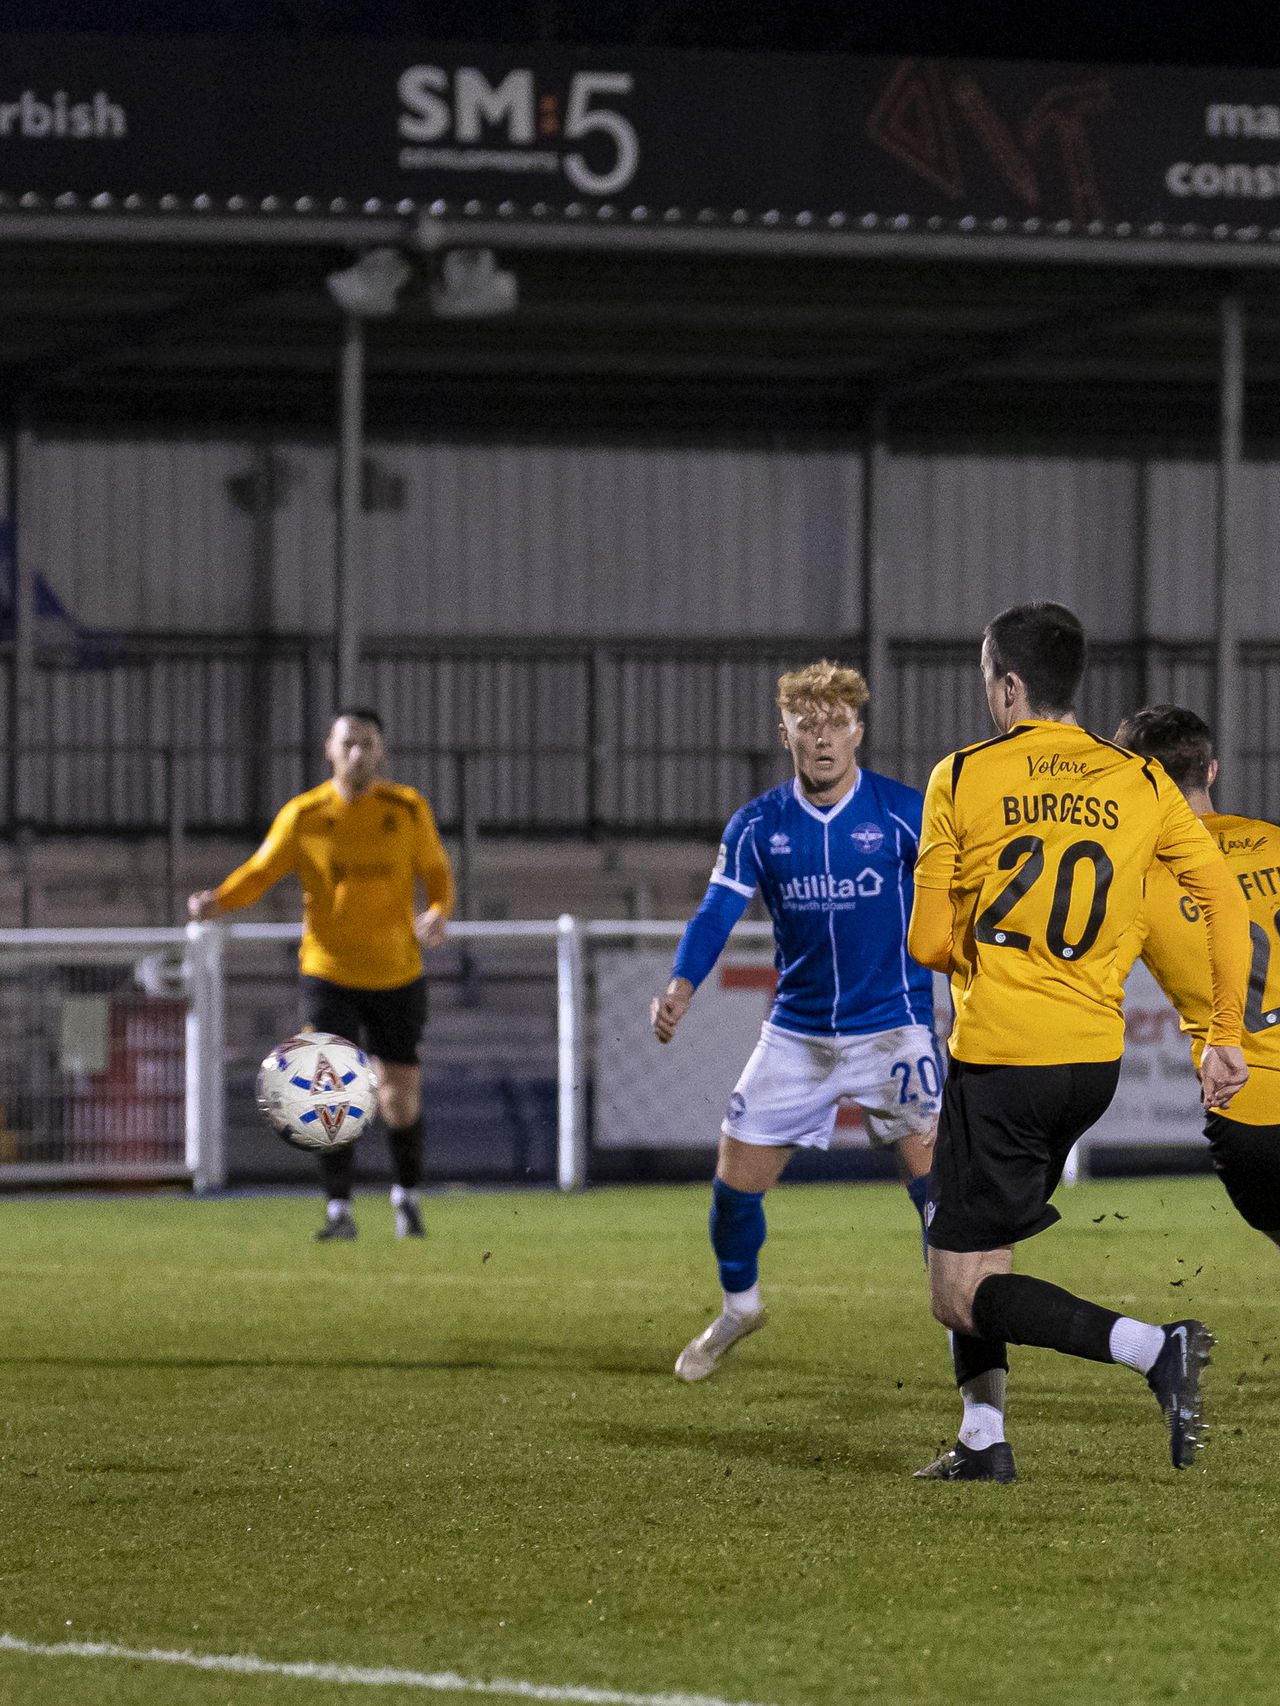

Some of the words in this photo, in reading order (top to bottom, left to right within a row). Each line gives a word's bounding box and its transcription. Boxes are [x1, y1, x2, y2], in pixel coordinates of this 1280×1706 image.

[1026, 753, 1090, 777] Volare
[1003, 793, 1119, 830] BURGESS
[779, 874, 856, 900] utilita
[974, 835, 1114, 961] 20
[890, 1056, 942, 1104] 20
